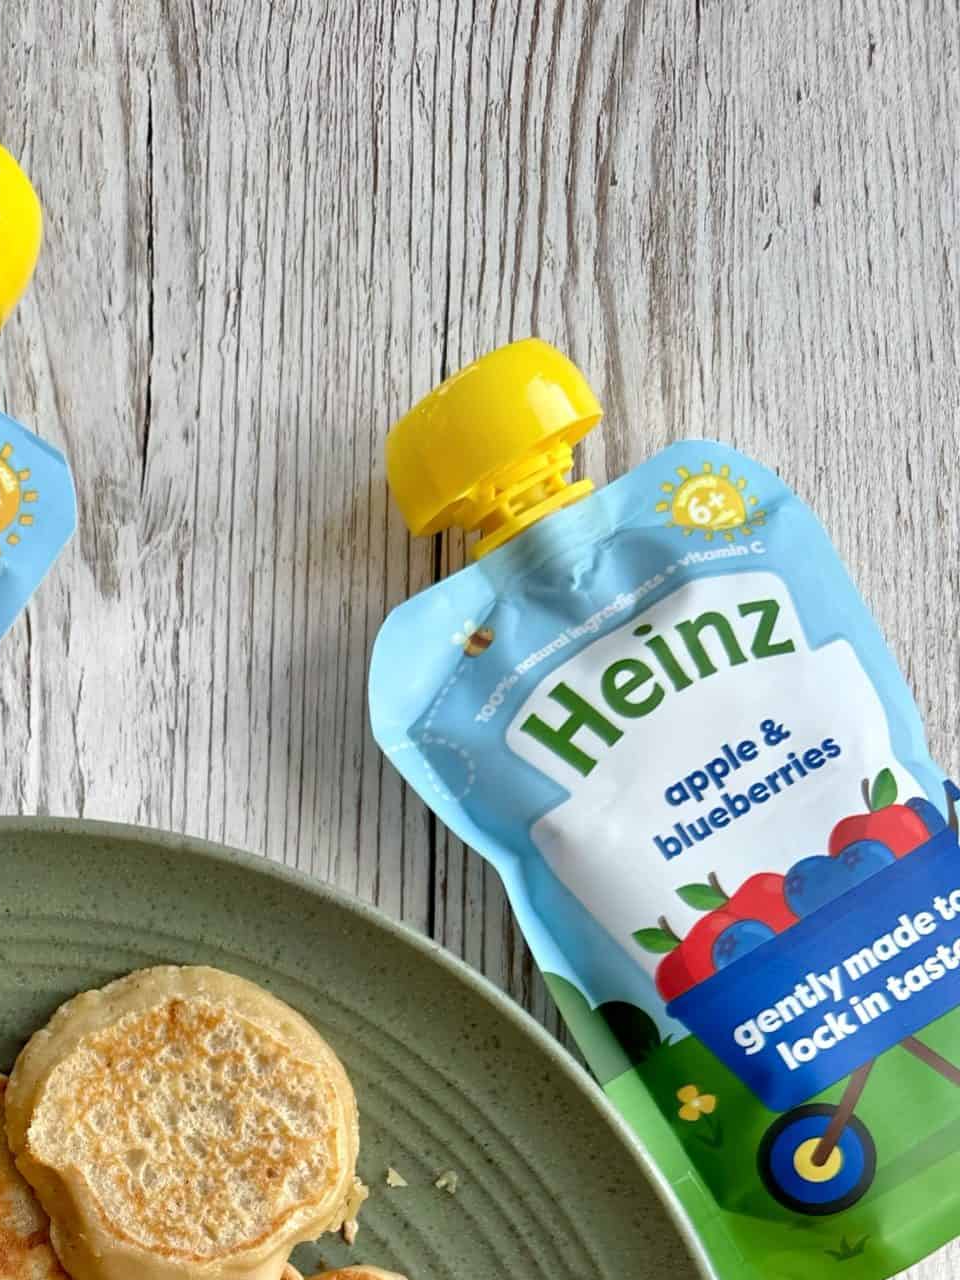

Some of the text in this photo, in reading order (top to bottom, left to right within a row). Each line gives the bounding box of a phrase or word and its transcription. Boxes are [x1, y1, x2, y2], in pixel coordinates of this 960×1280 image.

[688, 492, 726, 524] 6+
[514, 630, 571, 676] natural
[677, 543, 750, 567] vitamin
[750, 540, 767, 554] C
[520, 598, 796, 778] Heinz
[652, 735, 842, 861] blueberries
[664, 718, 791, 807] apple &
[733, 966, 844, 1055] gently
[842, 911, 938, 981] made
[775, 1011, 857, 1071] lock
[849, 992, 891, 1025] in
